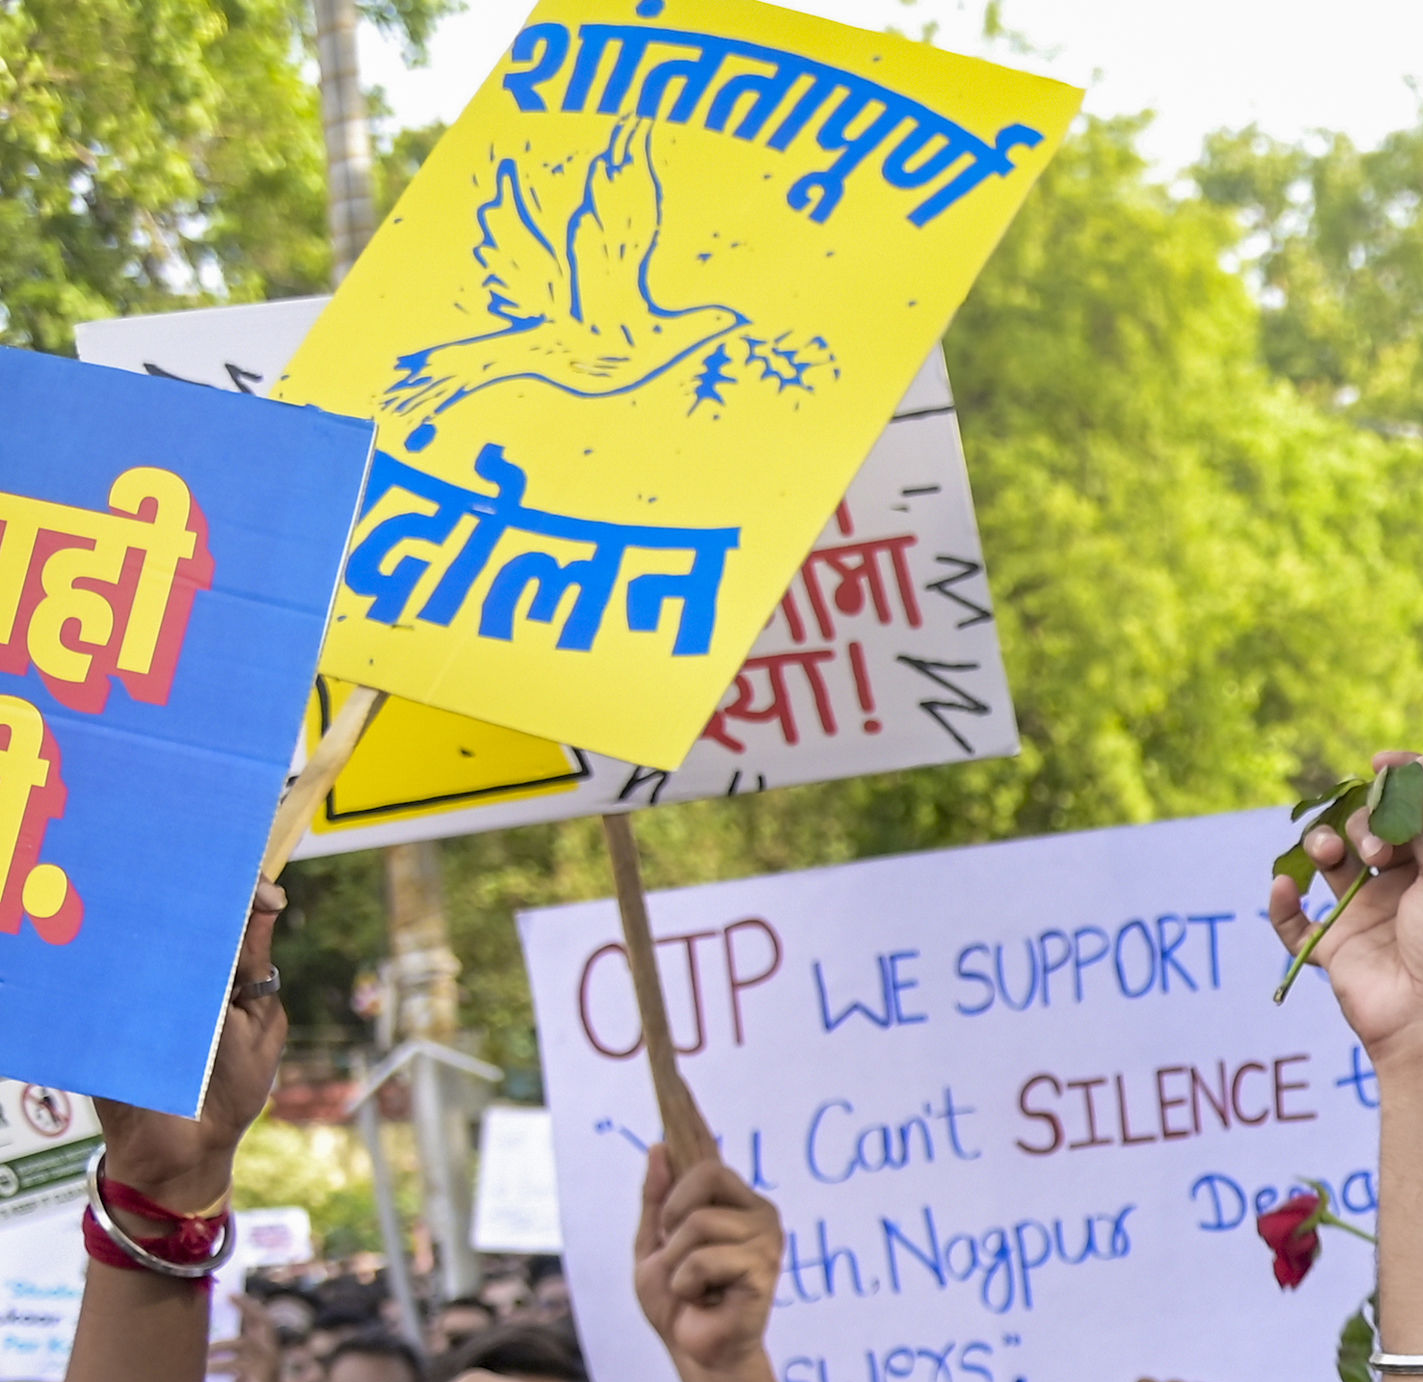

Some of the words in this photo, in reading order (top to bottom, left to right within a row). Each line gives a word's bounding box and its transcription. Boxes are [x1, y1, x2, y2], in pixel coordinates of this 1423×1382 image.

[503, 0, 1045, 228] शांततापूर्ण
[345, 422, 741, 656] ंदोलन
[813, 951, 928, 1031] WE
[954, 914, 1235, 1016] SUPPORT
[806, 1086, 981, 1184] Can't
[1016, 1056, 1317, 1157] SILENCE
[882, 1205, 1137, 1315] Nagpur
